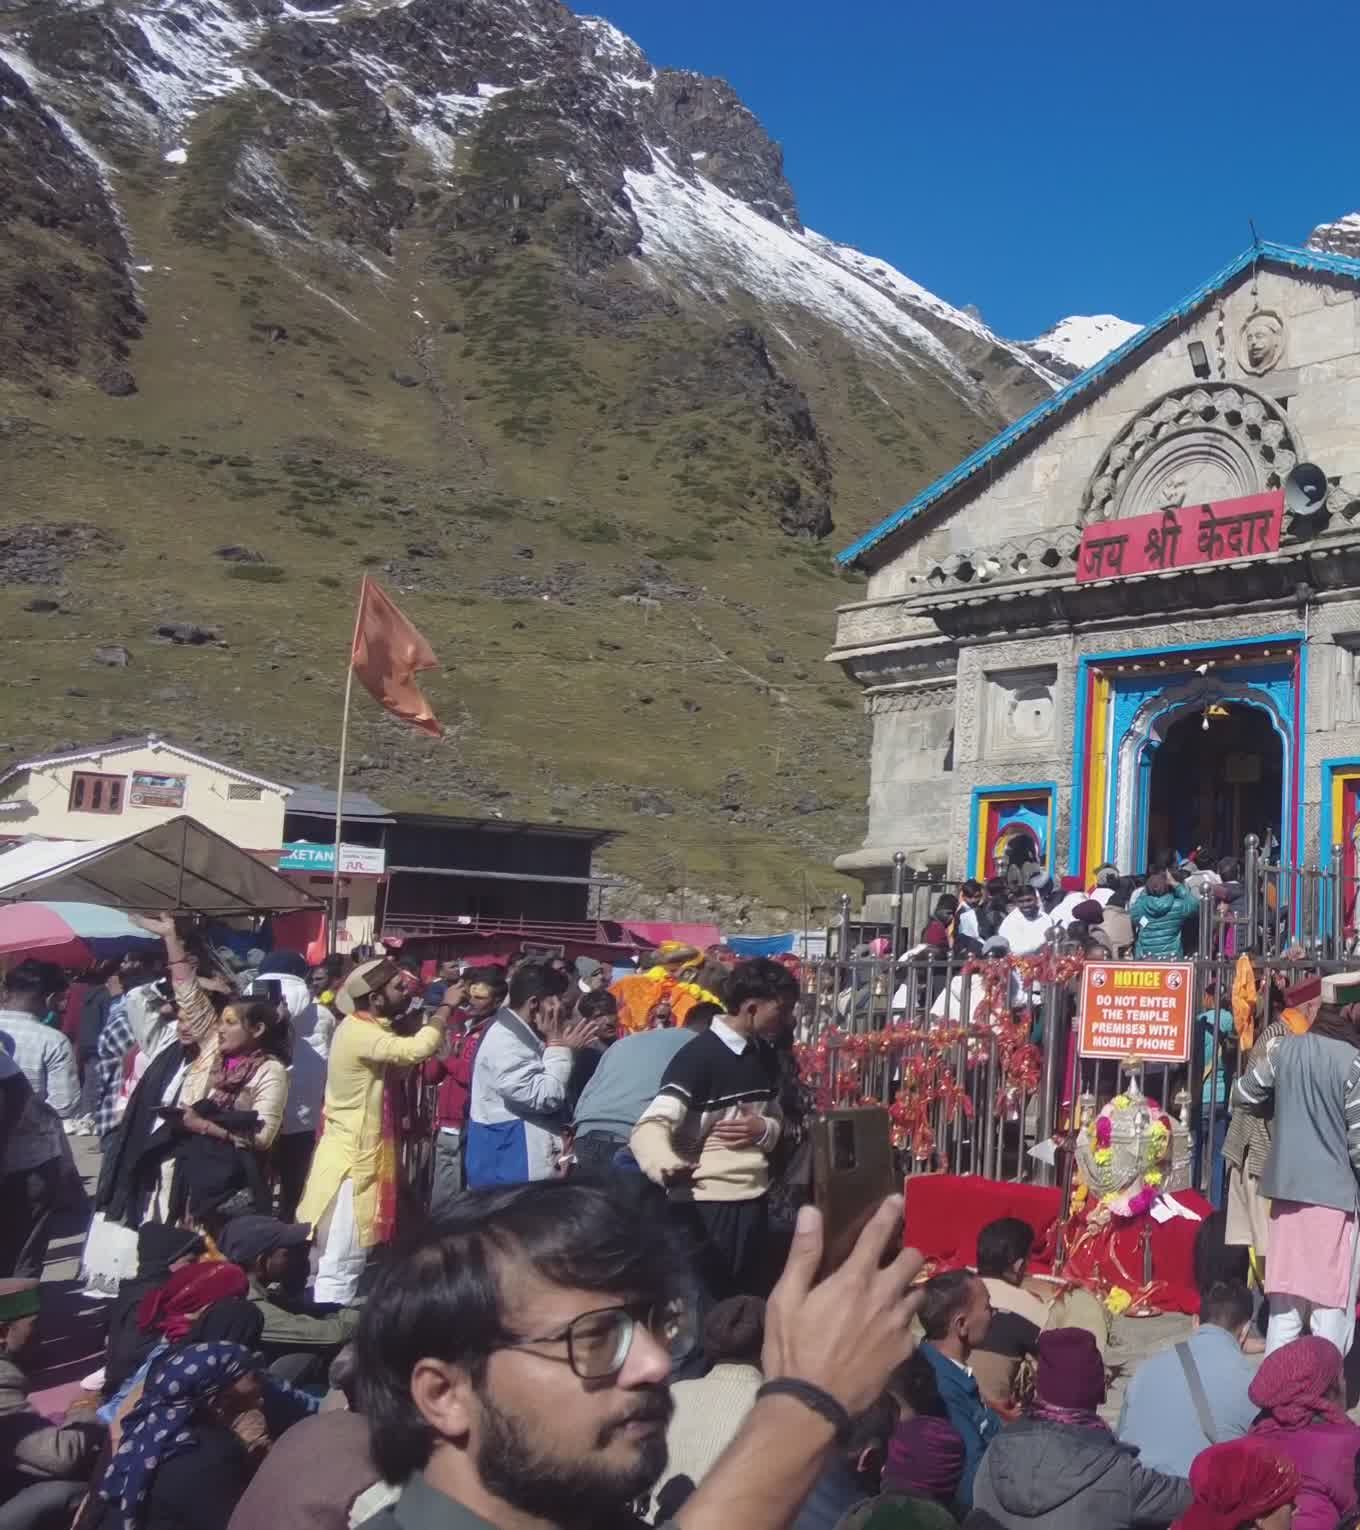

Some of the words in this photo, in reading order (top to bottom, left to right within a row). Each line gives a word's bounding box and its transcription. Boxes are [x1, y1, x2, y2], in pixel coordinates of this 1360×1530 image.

[1083, 534, 1129, 578] जय
[1144, 504, 1182, 568] श्री
[1197, 503, 1274, 561] केदार
[1114, 971, 1161, 986] NOTICE
[1096, 995, 1112, 1006] DO
[1114, 995, 1138, 1007] NOT
[1139, 997, 1177, 1008] ENTER
[1102, 1009, 1123, 1020] THE
[1126, 1010, 1169, 1022] TEMPLE
[1091, 1022, 1146, 1035] PREMISES
[1148, 1024, 1178, 1037] WITH
[1136, 1038, 1176, 1050] PHONE
